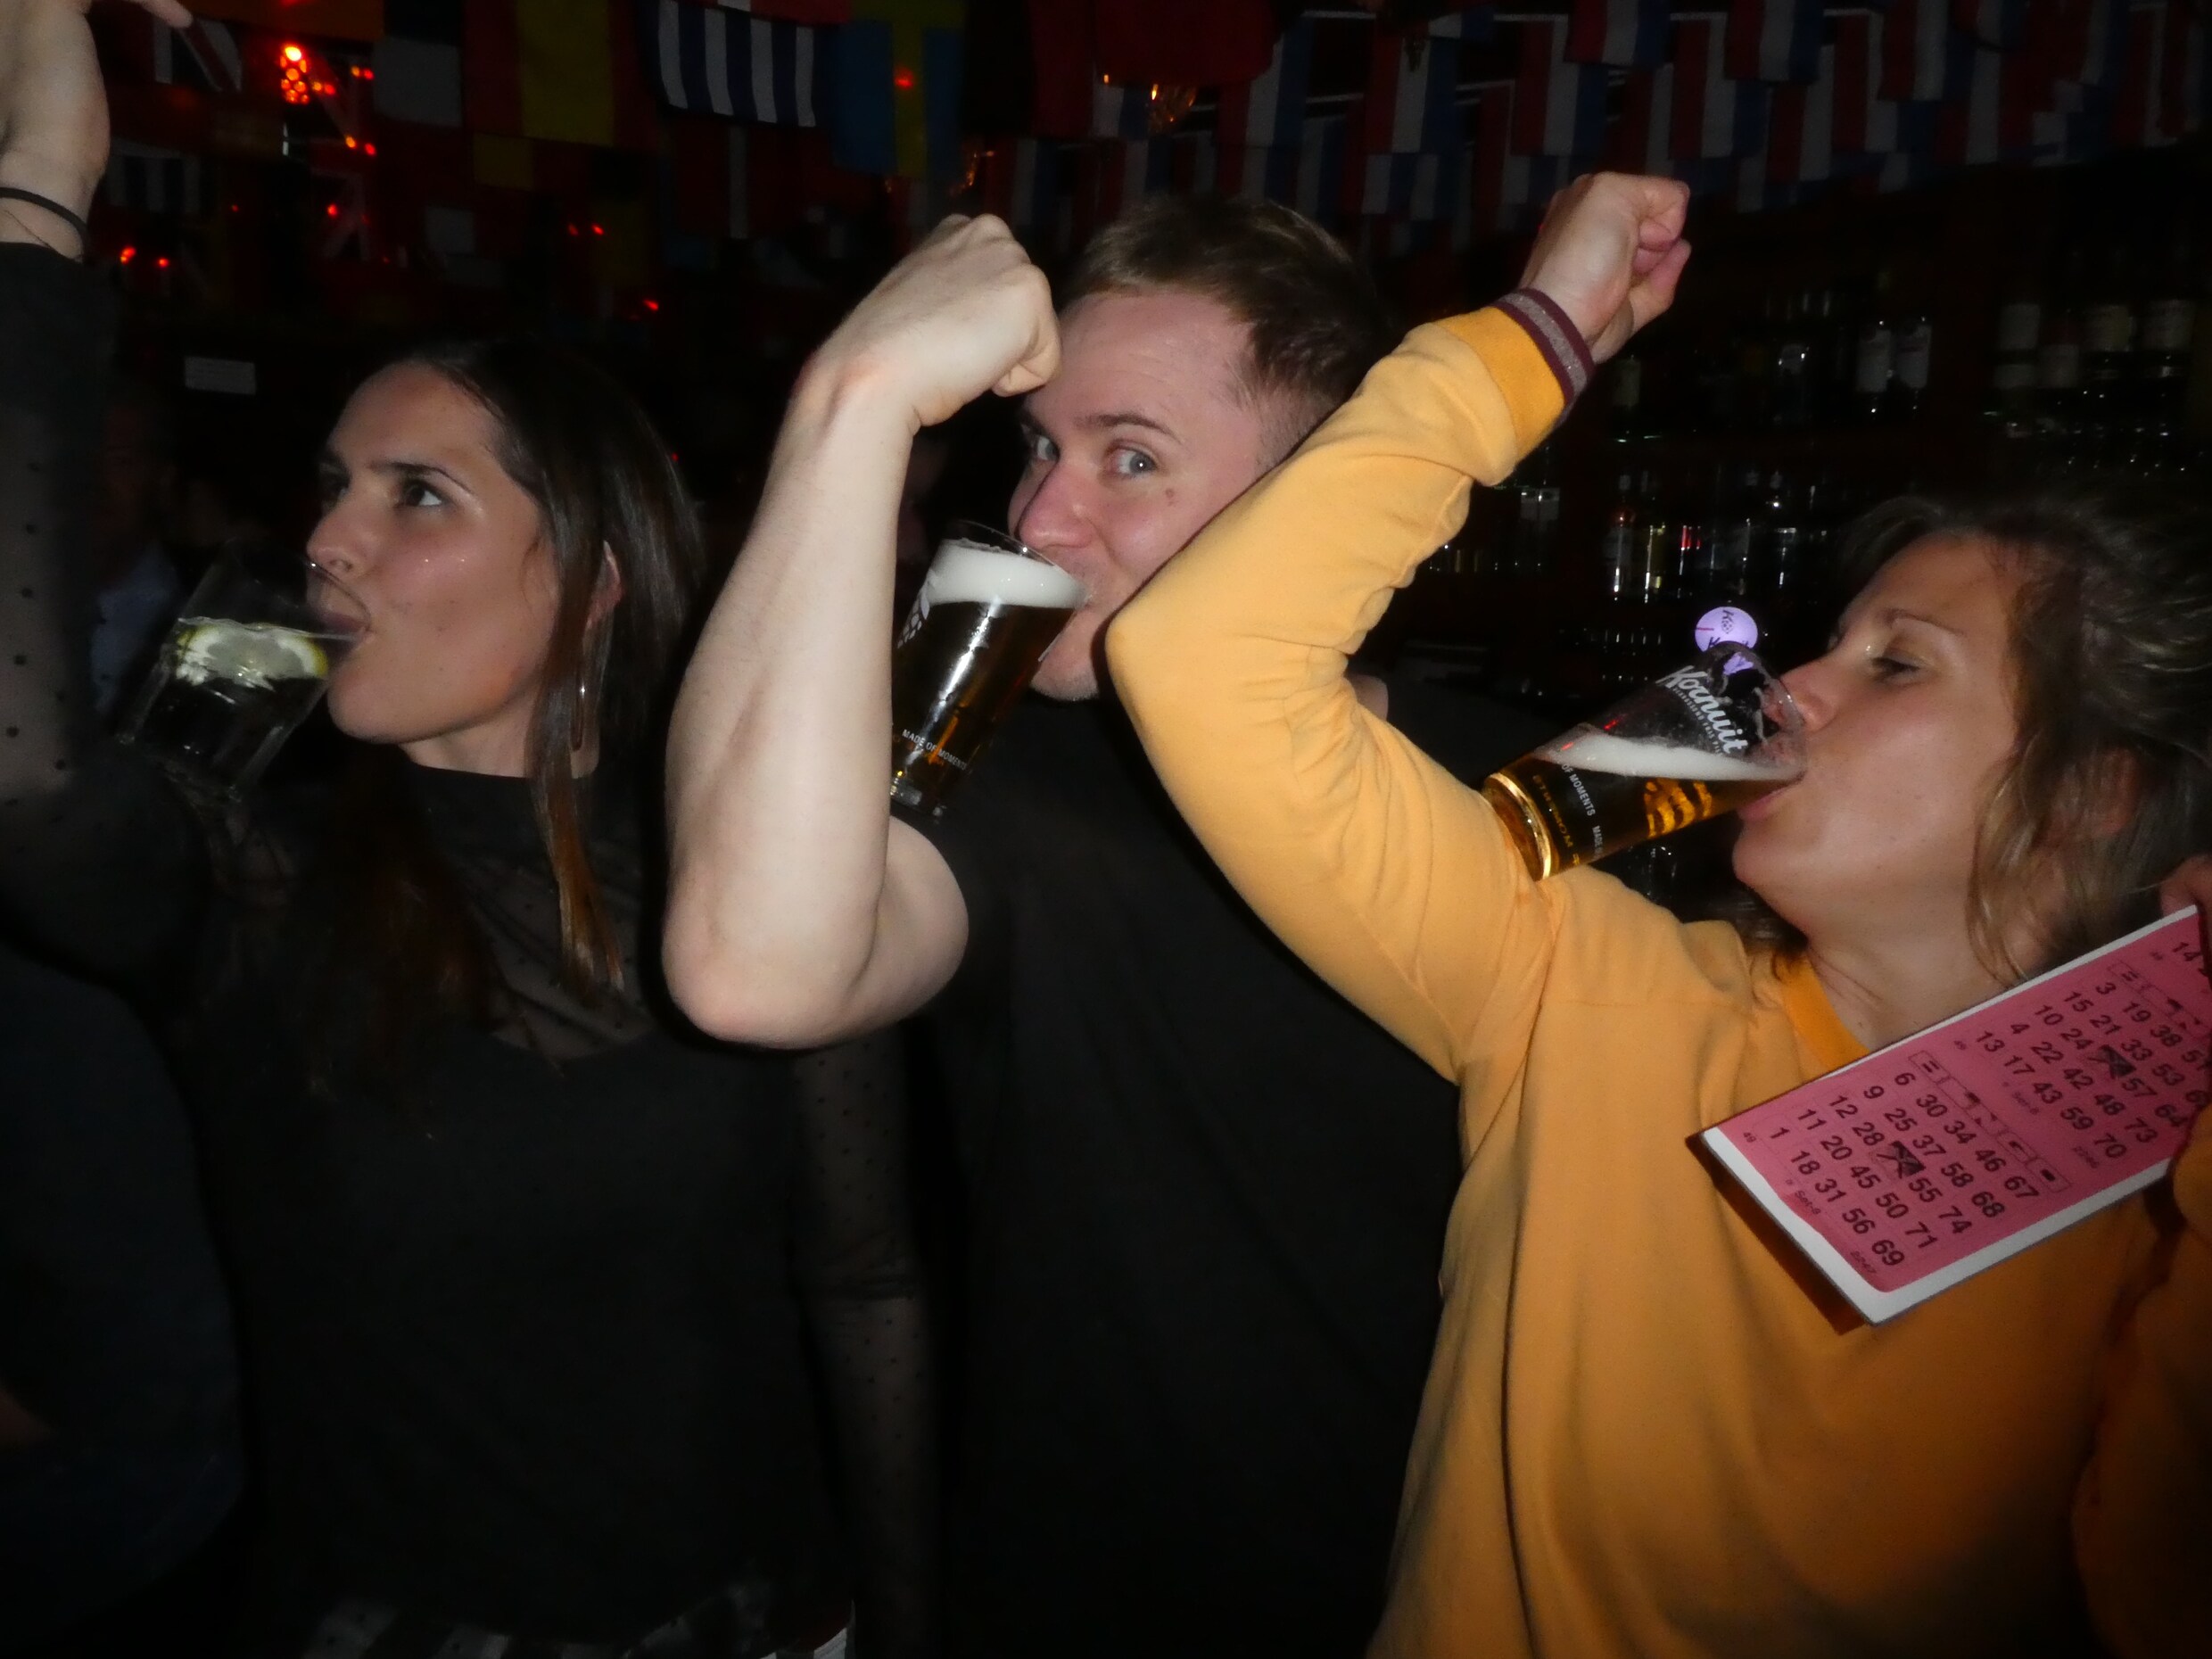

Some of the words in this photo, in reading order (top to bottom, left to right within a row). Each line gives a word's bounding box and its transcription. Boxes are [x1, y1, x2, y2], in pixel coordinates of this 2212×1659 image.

[902, 728, 926, 747] MADE
[926, 741, 937, 753] OF
[1655, 665, 1748, 754] Kornuit
[1569, 773, 1596, 816] MOMENTS
[2171, 941, 2200, 962] 14
[2034, 1003, 2065, 1027] 10
[2059, 1028, 2095, 1051] 24
[2120, 1077, 2158, 1098] 57
[2063, 991, 2095, 1013] 15
[2088, 1013, 2123, 1036] 21
[2119, 1037, 2153, 1062] 33
[2151, 1062, 2186, 1087] 53
[2094, 981, 2117, 996] 3
[2121, 1001, 2152, 1023] 19
[2149, 1024, 2183, 1048] 38
[1894, 1072, 1916, 1086] 6
[1915, 1094, 1948, 1118] 30
[1943, 1119, 1977, 1145] 34
[1974, 1149, 2007, 1173] 46
[2003, 1175, 2040, 1200] 67
[1975, 1029, 2007, 1053] 13
[2003, 1054, 2036, 1076] 17
[2032, 1082, 2064, 1105] 43
[2059, 1106, 2095, 1131] 59
[2092, 1131, 2128, 1160] 70
[2009, 1023, 2032, 1036] 4
[2029, 1040, 2065, 1065] 22
[2062, 1068, 2095, 1091] 42
[2092, 1094, 2126, 1117] 48
[2123, 1117, 2159, 1144] 73
[1769, 1127, 1791, 1140] 1
[1789, 1150, 1821, 1176] 18
[1813, 1178, 1847, 1204] 31
[1841, 1207, 1877, 1235] 56
[1870, 1238, 1906, 1267] 69
[1796, 1108, 1828, 1131] 11
[1820, 1135, 1853, 1161] 20
[1849, 1165, 1882, 1190] 45
[1875, 1192, 1910, 1220] 50
[1903, 1220, 1938, 1250] 71
[1828, 1094, 1859, 1120] 12
[1851, 1121, 1886, 1147] 28
[1907, 1177, 1944, 1203] 55
[1937, 1204, 1973, 1234] 74
[1862, 1085, 1886, 1100] 9
[1884, 1108, 1919, 1133] 25
[1911, 1134, 1947, 1157] 37
[1940, 1161, 1975, 1189] 58
[1970, 1191, 2006, 1219] 68
